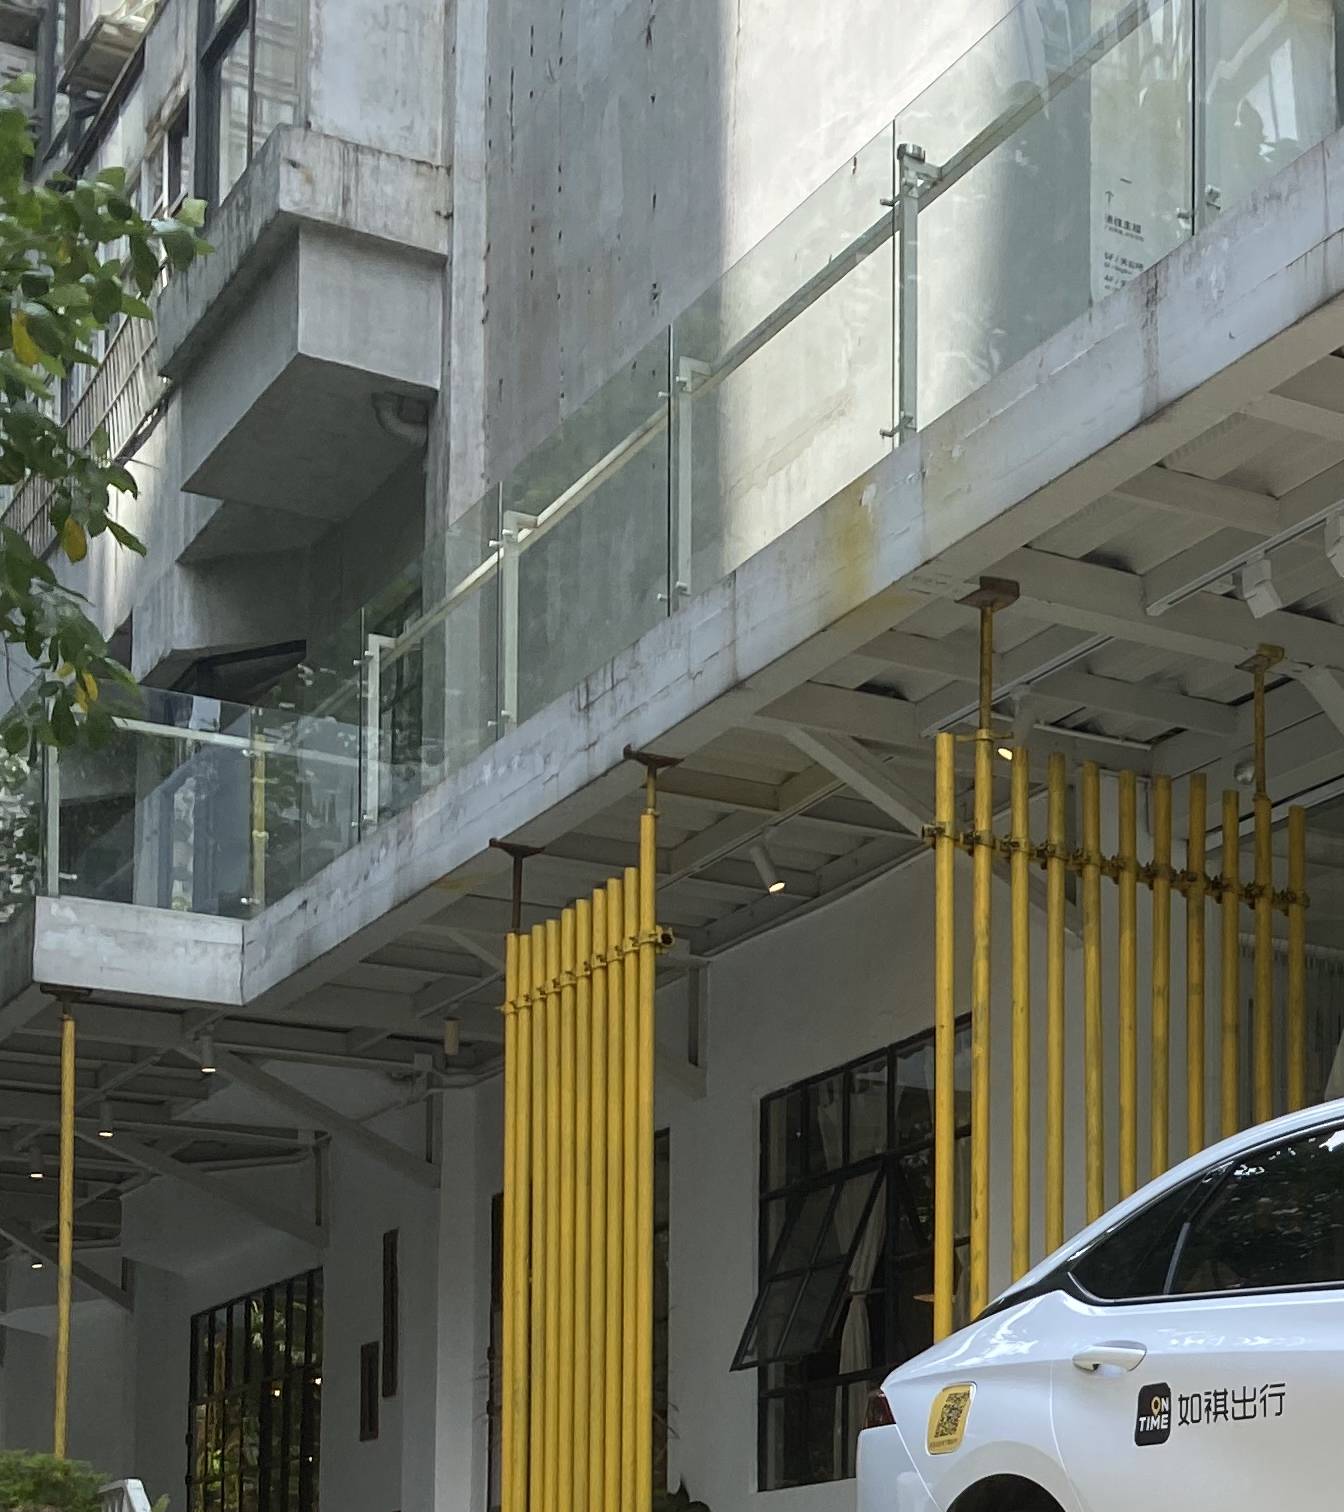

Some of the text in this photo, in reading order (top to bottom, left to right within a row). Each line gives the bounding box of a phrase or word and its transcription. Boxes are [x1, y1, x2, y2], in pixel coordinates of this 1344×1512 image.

[1150, 1396, 1169, 1416] ON
[1178, 1382, 1286, 1427] 如祺出行
[1138, 1414, 1169, 1432] TIME
